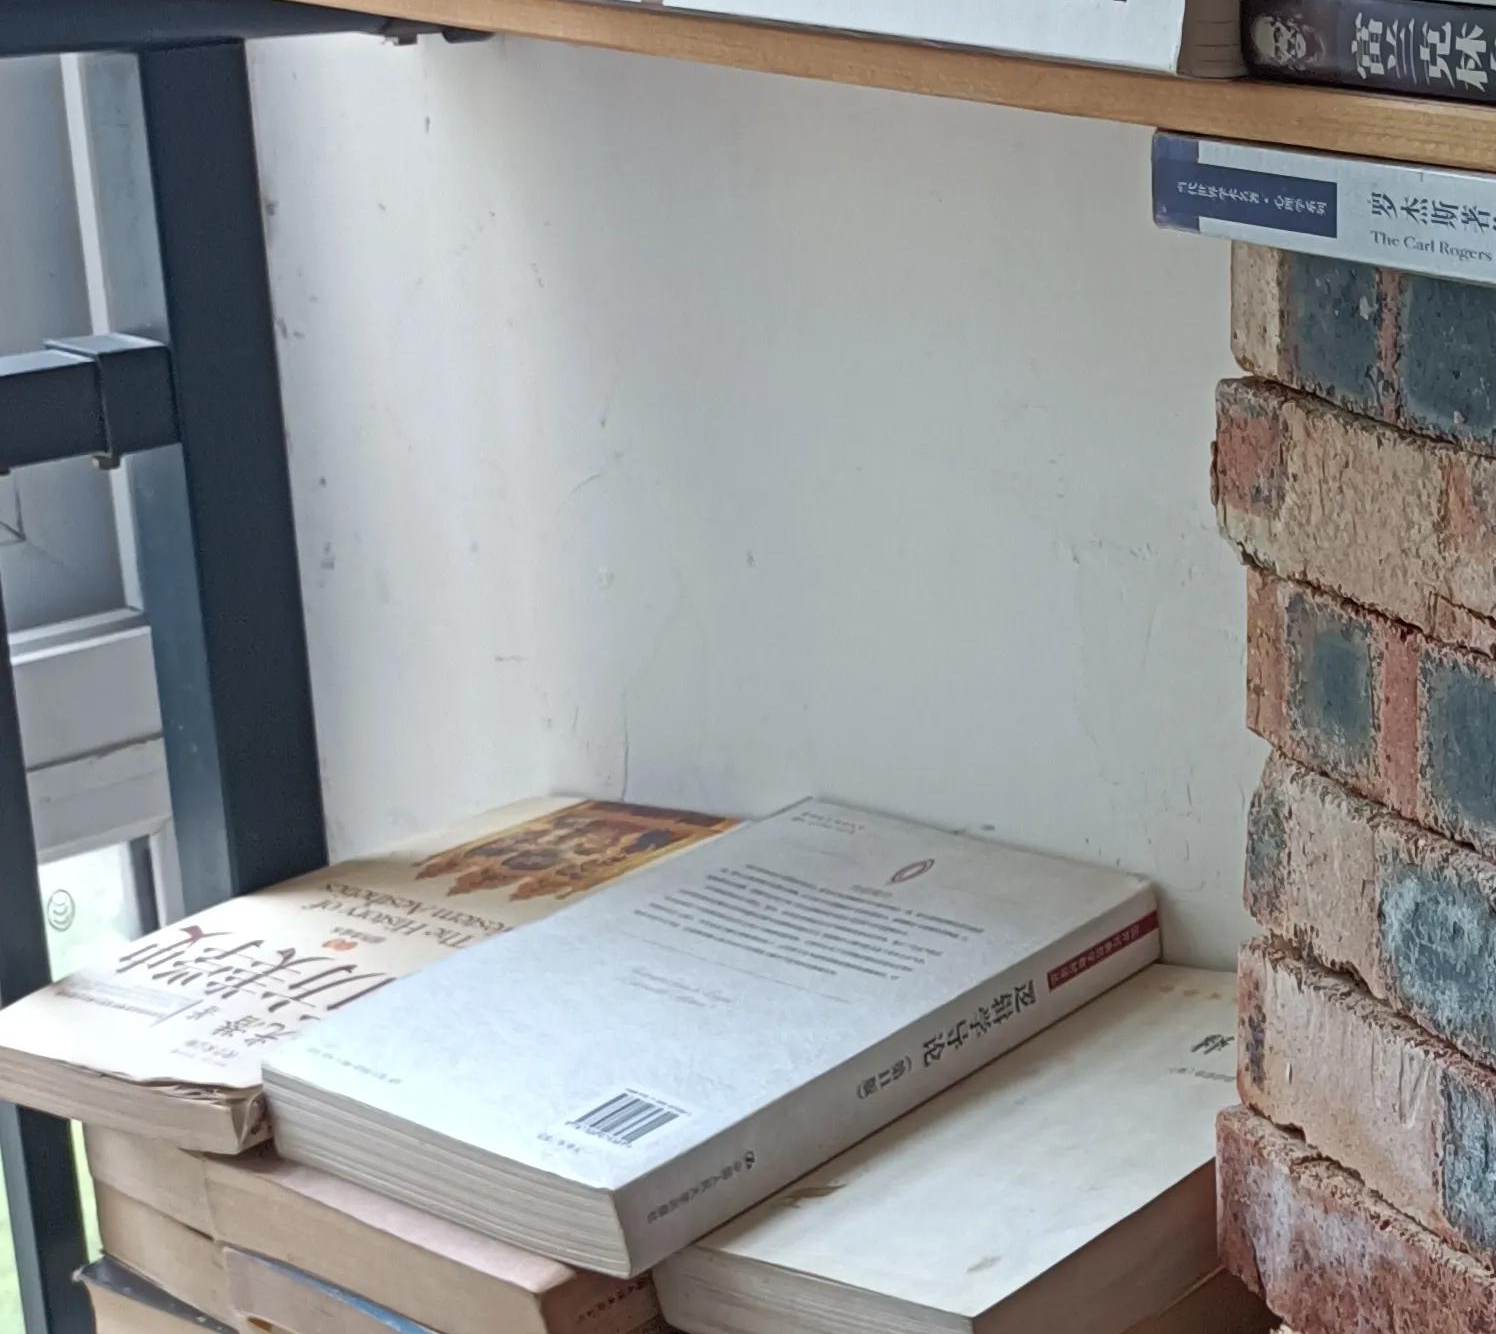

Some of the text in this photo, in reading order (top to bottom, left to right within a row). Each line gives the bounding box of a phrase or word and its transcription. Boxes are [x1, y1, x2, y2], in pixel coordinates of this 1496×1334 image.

[1370, 229, 1399, 249] The
[1403, 234, 1438, 254] Carl
[1438, 240, 1493, 263] Rogers
[324, 882, 513, 937] estern Aesthetics
[346, 905, 425, 936] History
[922, 978, 1038, 1069] 逻辑学导论
